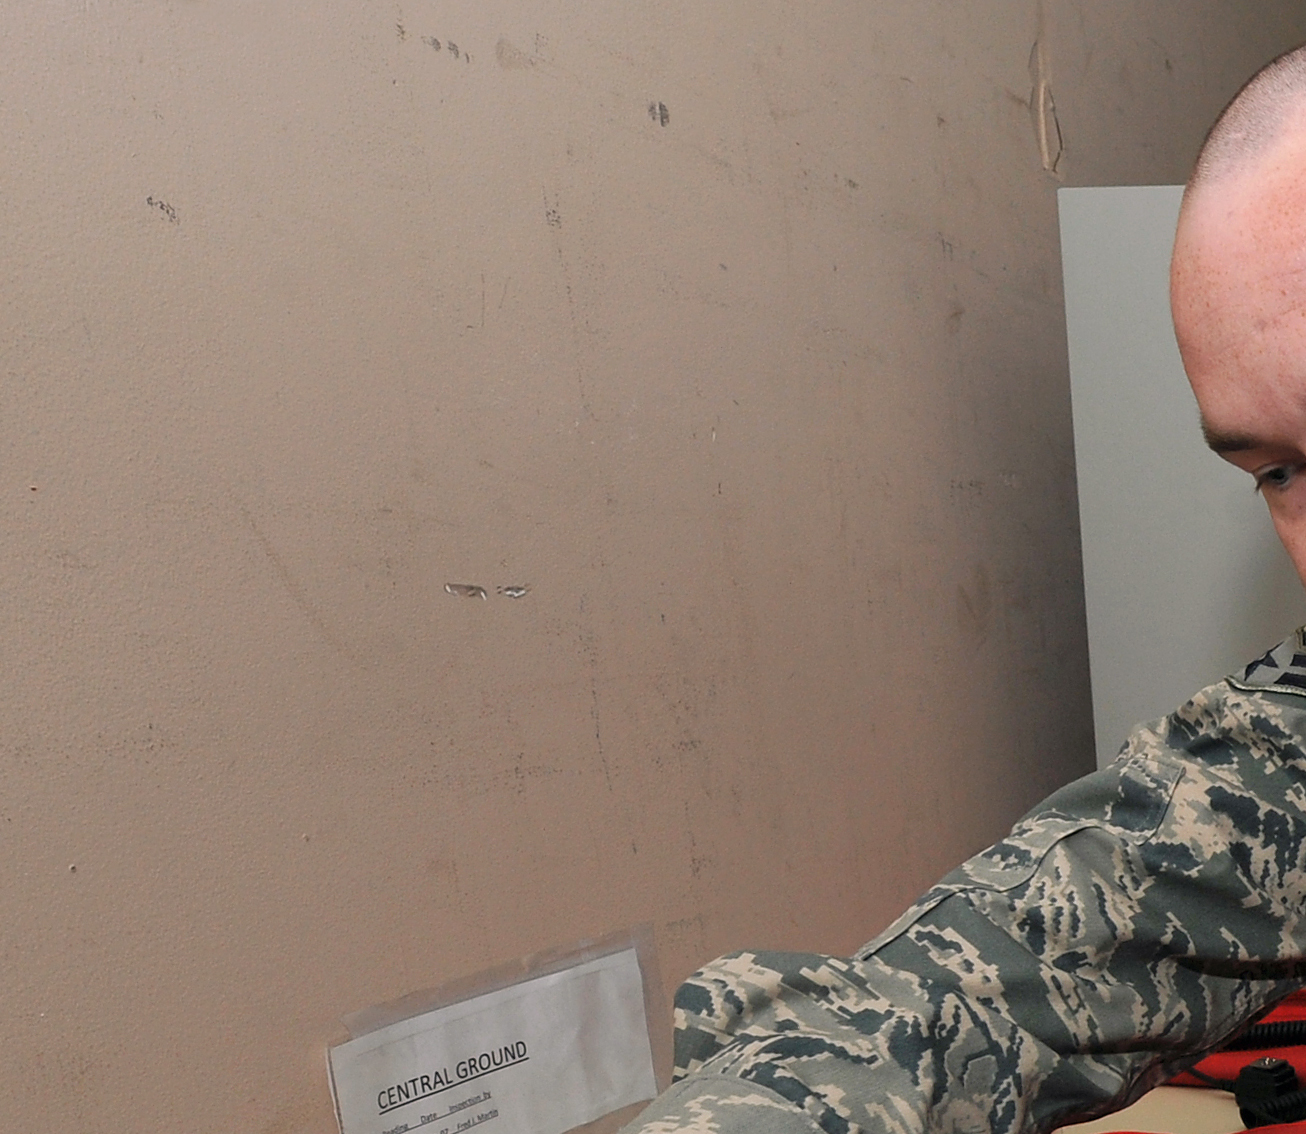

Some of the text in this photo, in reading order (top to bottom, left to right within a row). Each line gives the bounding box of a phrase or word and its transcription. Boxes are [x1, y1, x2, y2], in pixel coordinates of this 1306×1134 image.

[378, 1041, 527, 1109] CENTRAL GROUND
[420, 1112, 437, 1124] Date
[449, 1094, 481, 1112] Inspection
[483, 1091, 491, 1101] by
[457, 1118, 471, 1131] Fred
[477, 1109, 499, 1123] Martin
